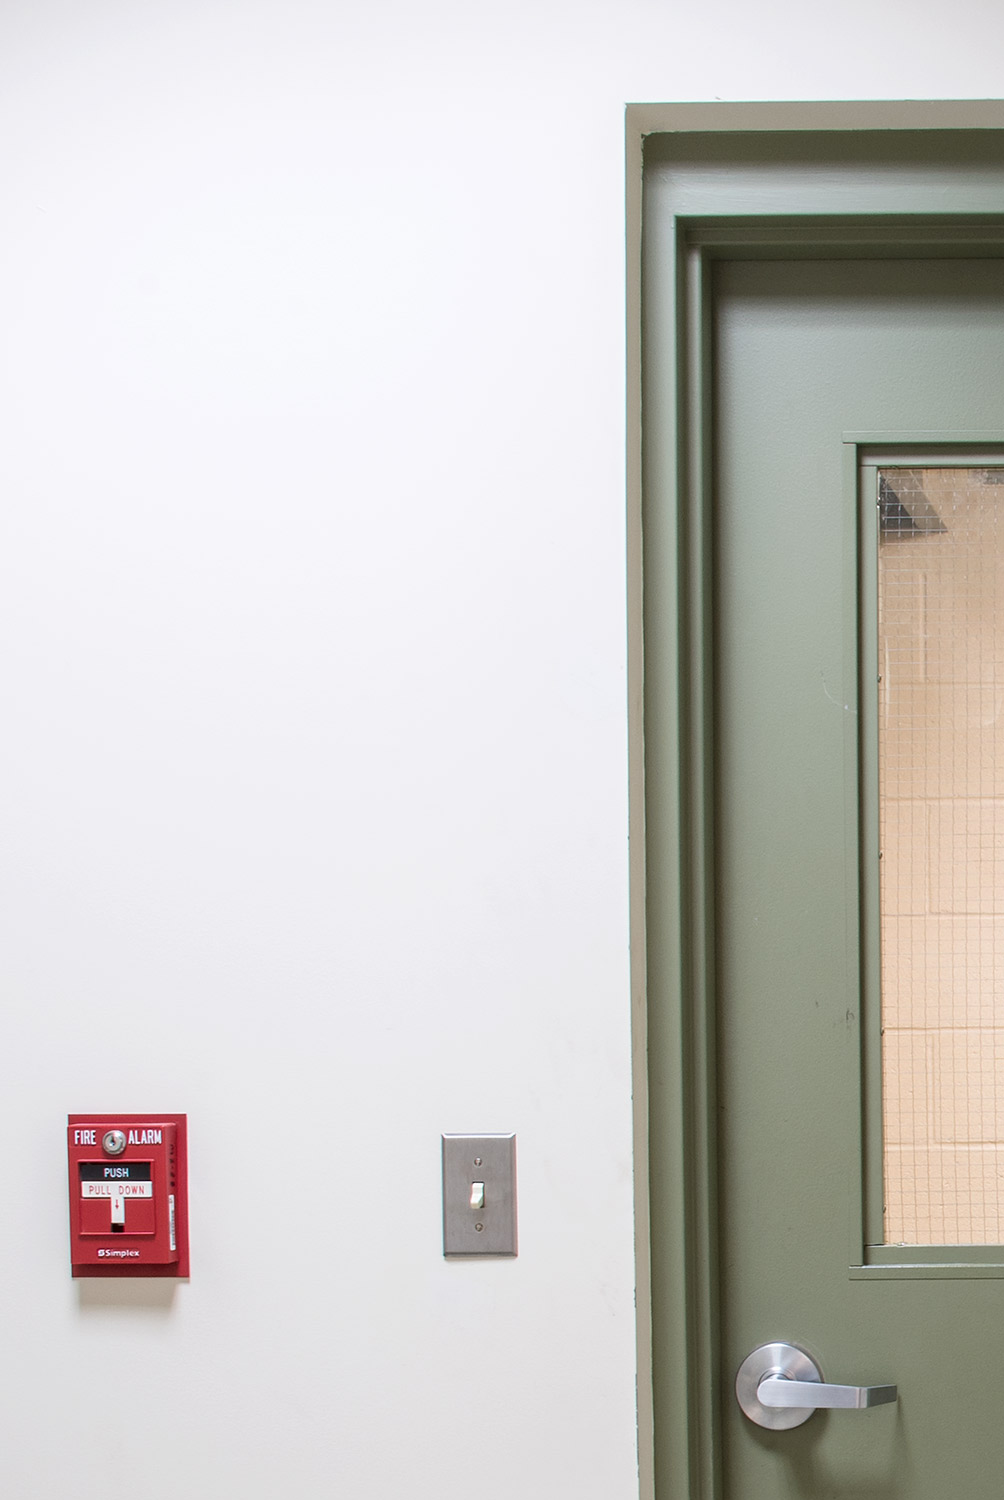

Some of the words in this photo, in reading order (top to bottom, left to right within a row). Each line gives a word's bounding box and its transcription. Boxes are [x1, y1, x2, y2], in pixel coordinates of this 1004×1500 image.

[74, 1130, 96, 1145] FIRE
[128, 1130, 162, 1144] ALARM
[104, 1167, 129, 1178] PUSH
[89, 1185, 112, 1195] PULL
[118, 1185, 145, 1195] DOWN
[105, 1249, 140, 1258] Simplex
